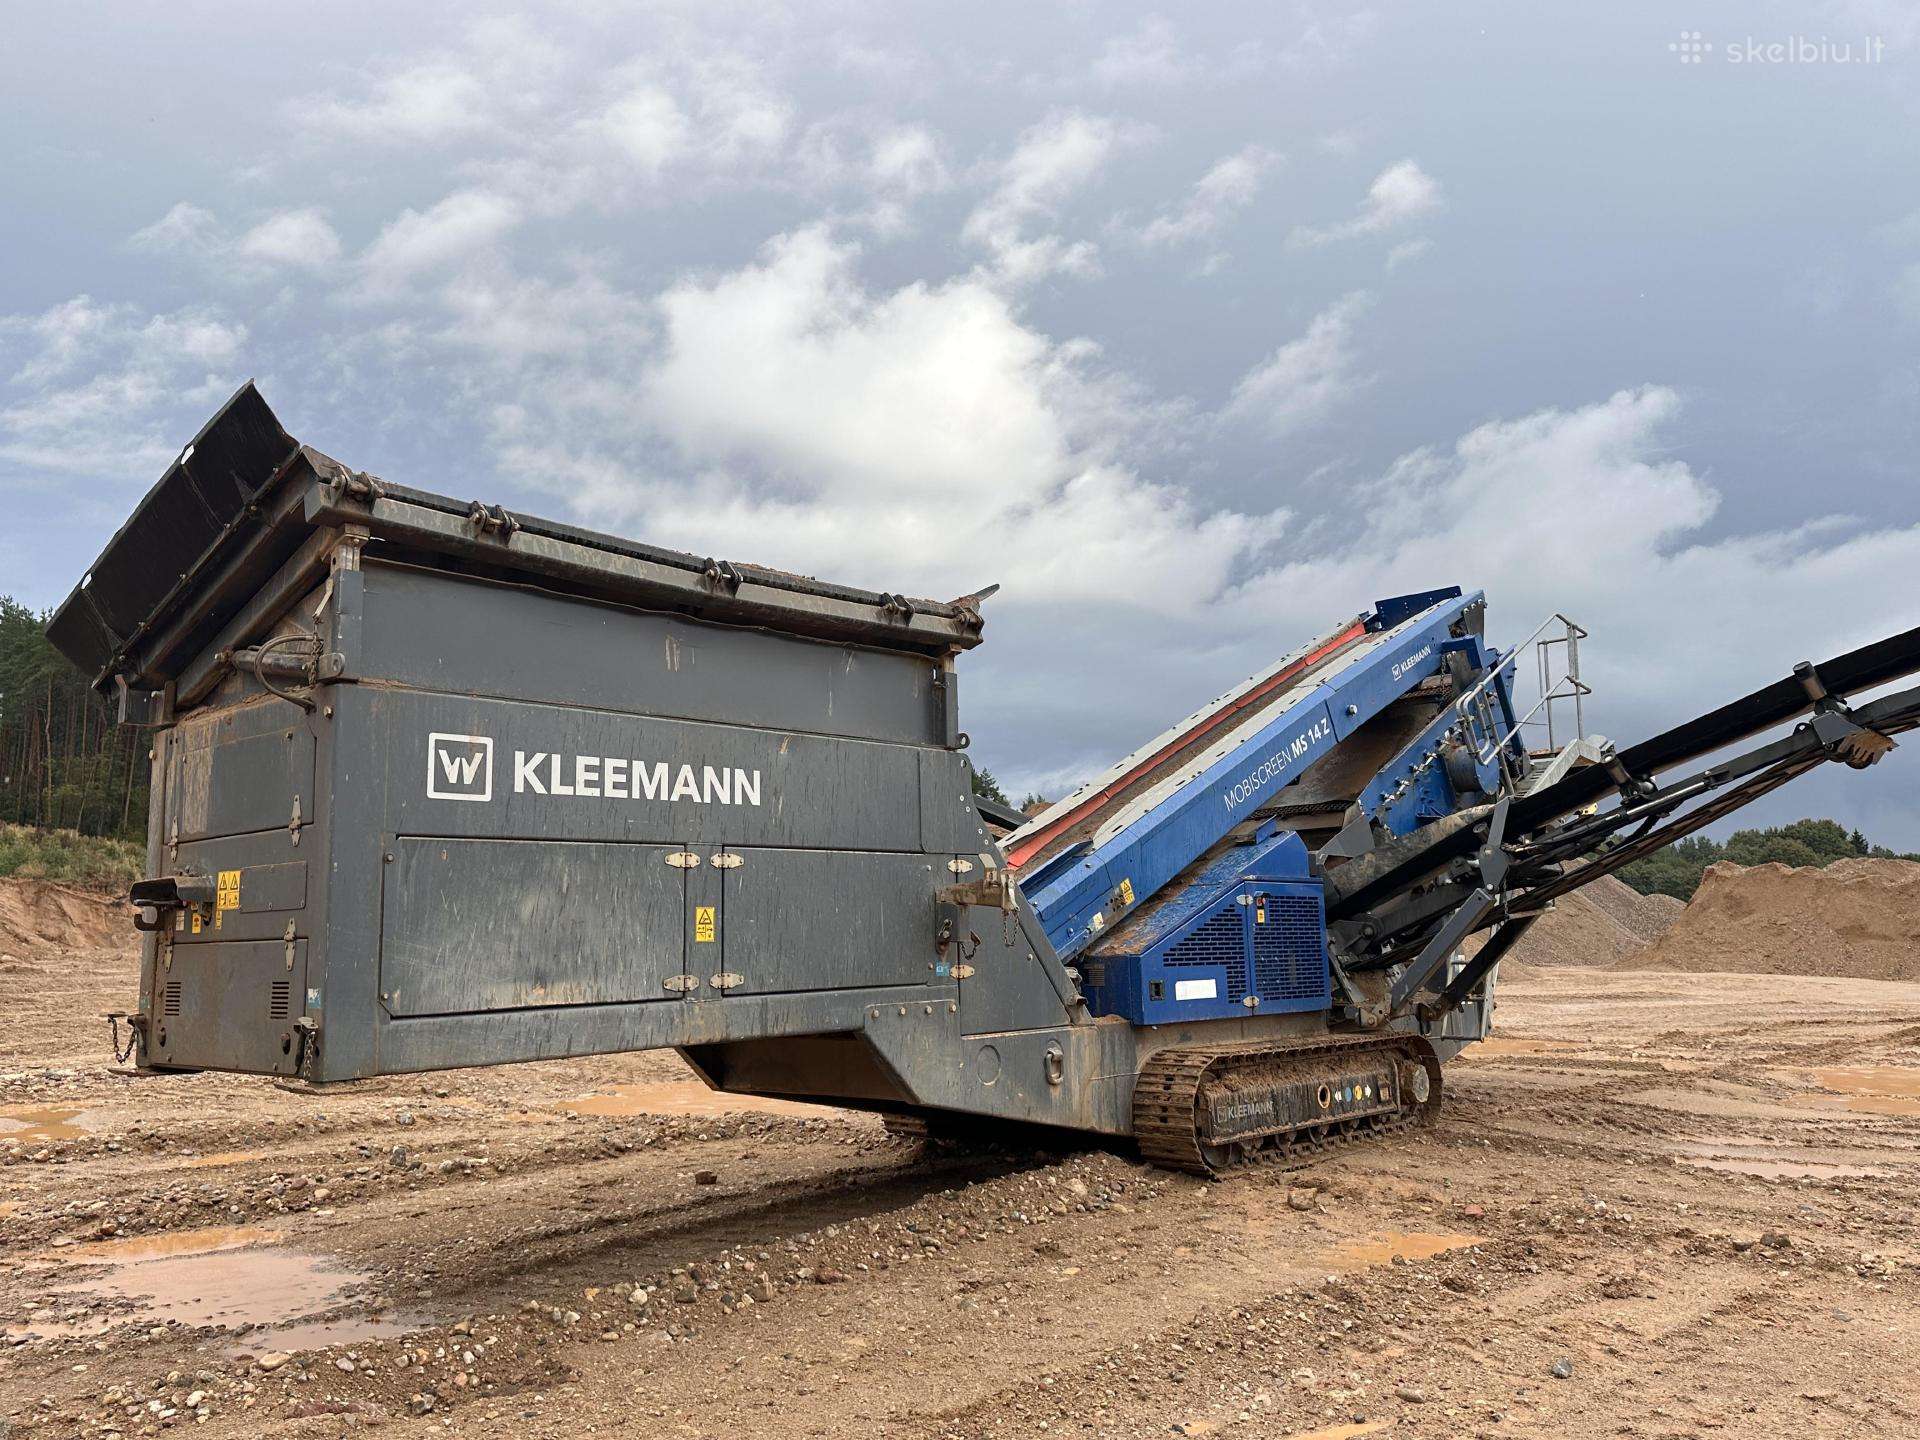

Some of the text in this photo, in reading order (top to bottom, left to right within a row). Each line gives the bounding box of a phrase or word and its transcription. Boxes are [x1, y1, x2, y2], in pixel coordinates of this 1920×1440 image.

[1400, 644, 1431, 673] KLEEMANN
[513, 750, 761, 806] KLEEMANN
[1223, 717, 1330, 812] MOBISCREEN MS 14 Z
